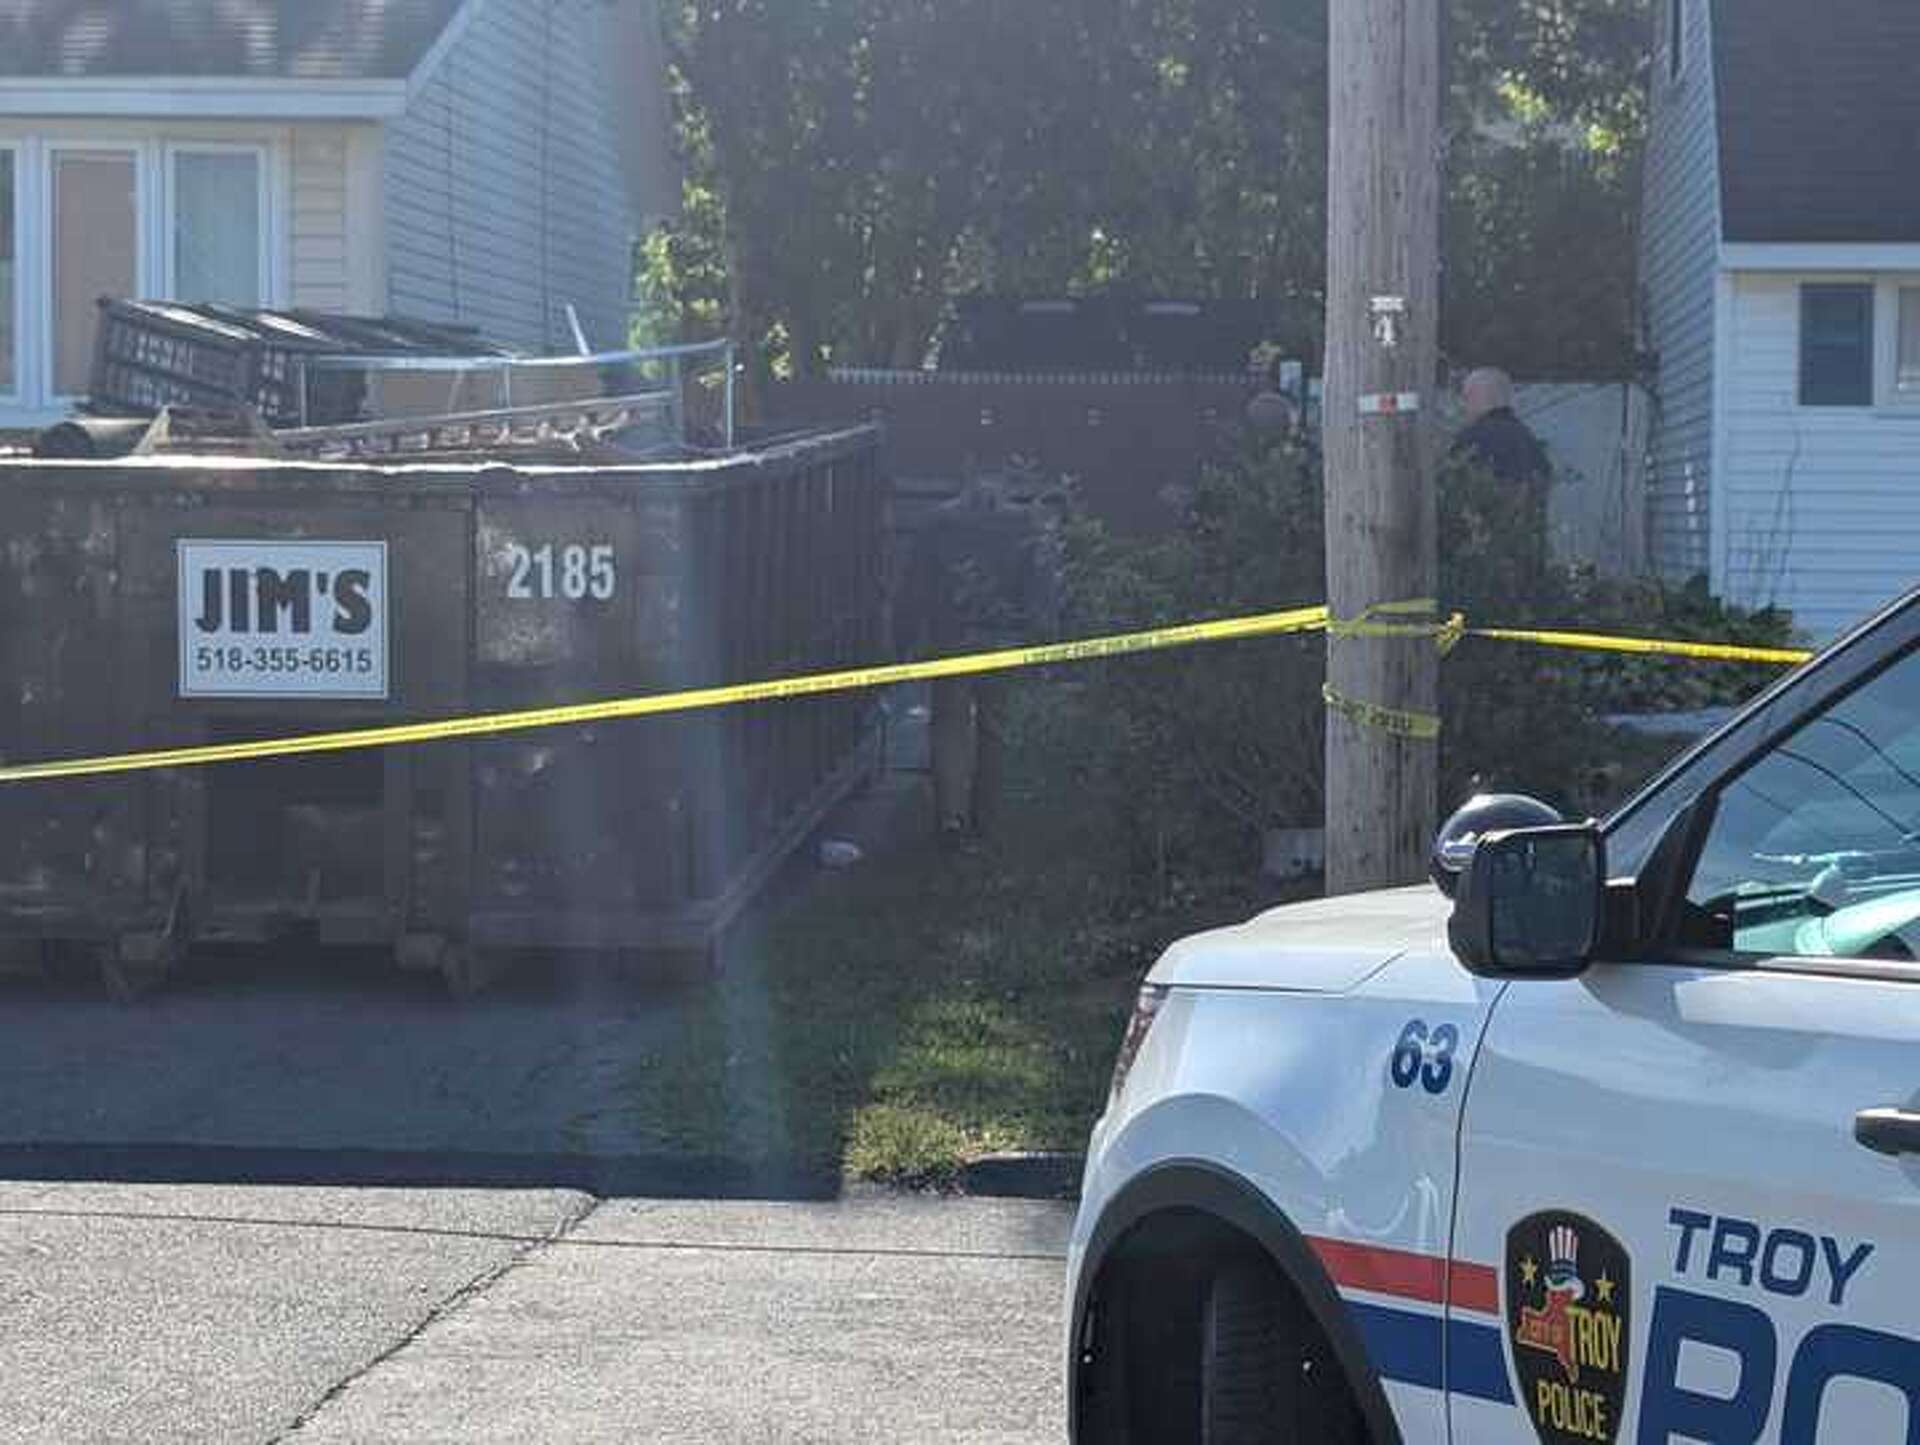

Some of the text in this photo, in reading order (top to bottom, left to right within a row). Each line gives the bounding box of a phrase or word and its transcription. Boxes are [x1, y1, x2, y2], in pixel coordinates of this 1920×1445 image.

[195, 567, 372, 634] JIM'S
[508, 544, 615, 599] 2185
[197, 648, 372, 673] 518-355-6615
[1391, 1018, 1458, 1094] 63
[1669, 1207, 1875, 1305] TROY
[1565, 1305, 1622, 1372] TROY
[1537, 1378, 1607, 1440] POLICE
